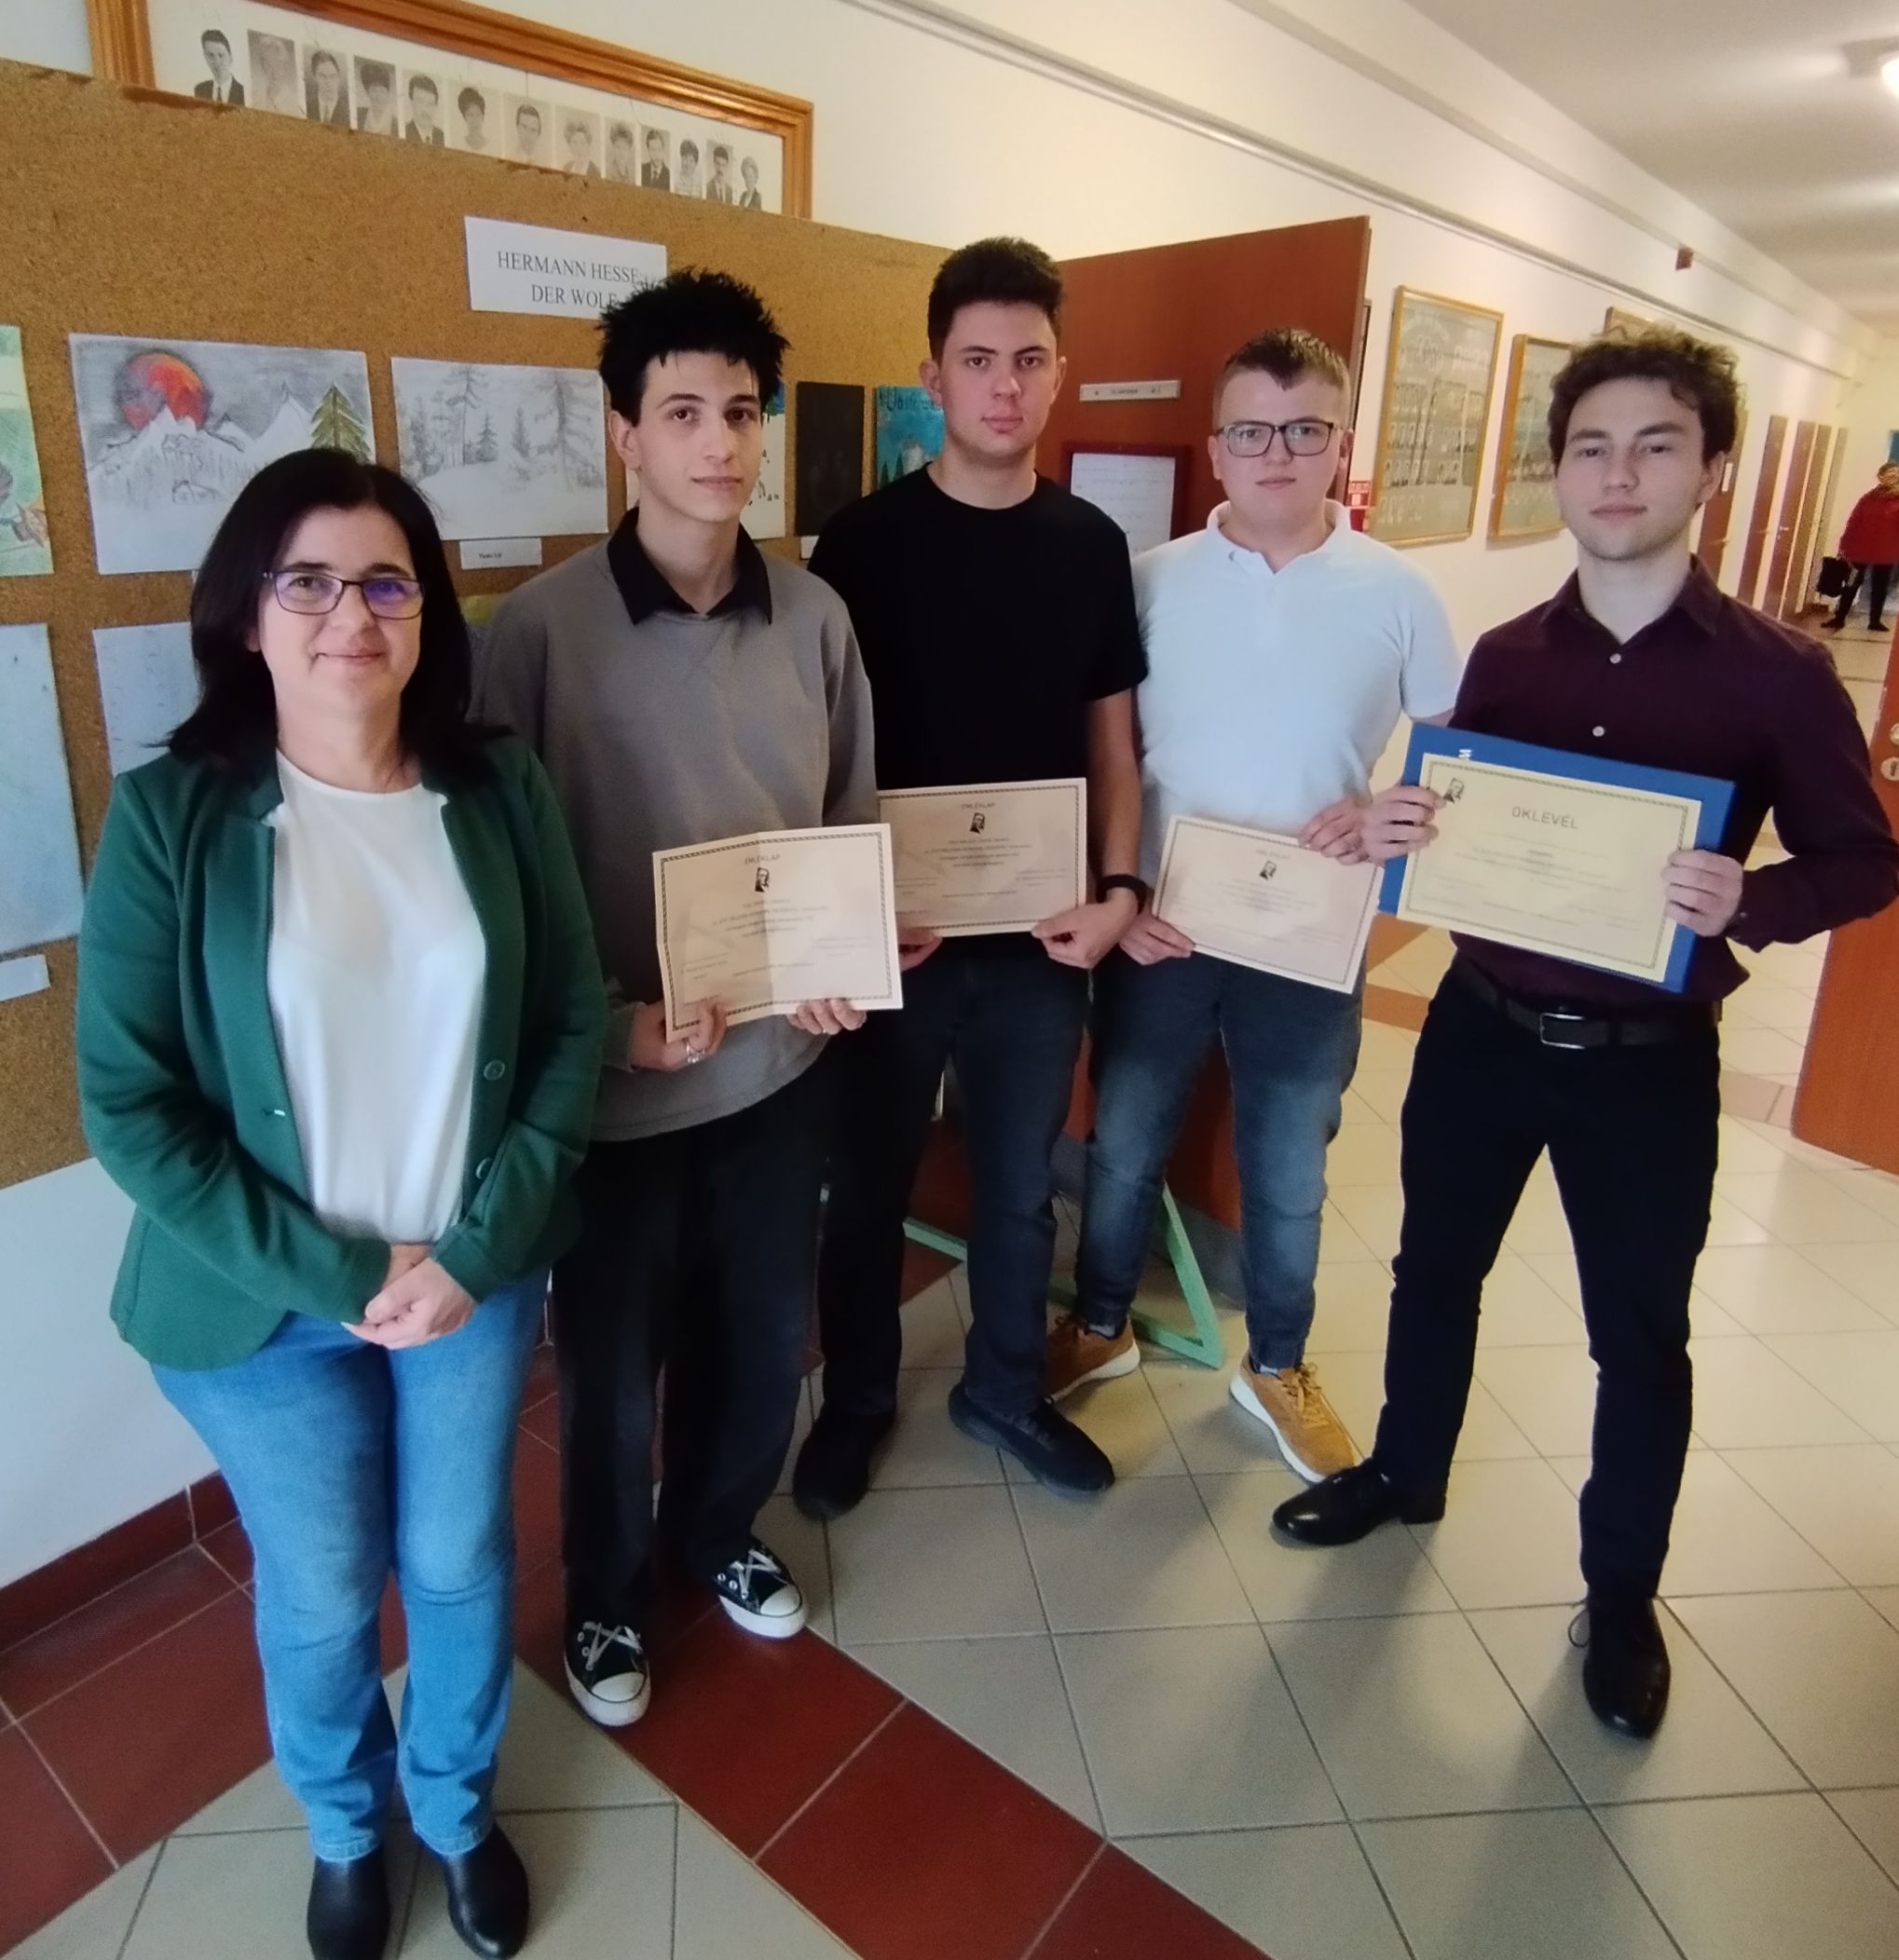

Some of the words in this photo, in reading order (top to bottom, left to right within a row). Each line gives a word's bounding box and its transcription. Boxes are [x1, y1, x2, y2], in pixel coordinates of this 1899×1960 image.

[498, 251, 586, 278] HERMANN
[532, 284, 566, 305] DER
[1511, 806, 1578, 829] OKLEVÉL
